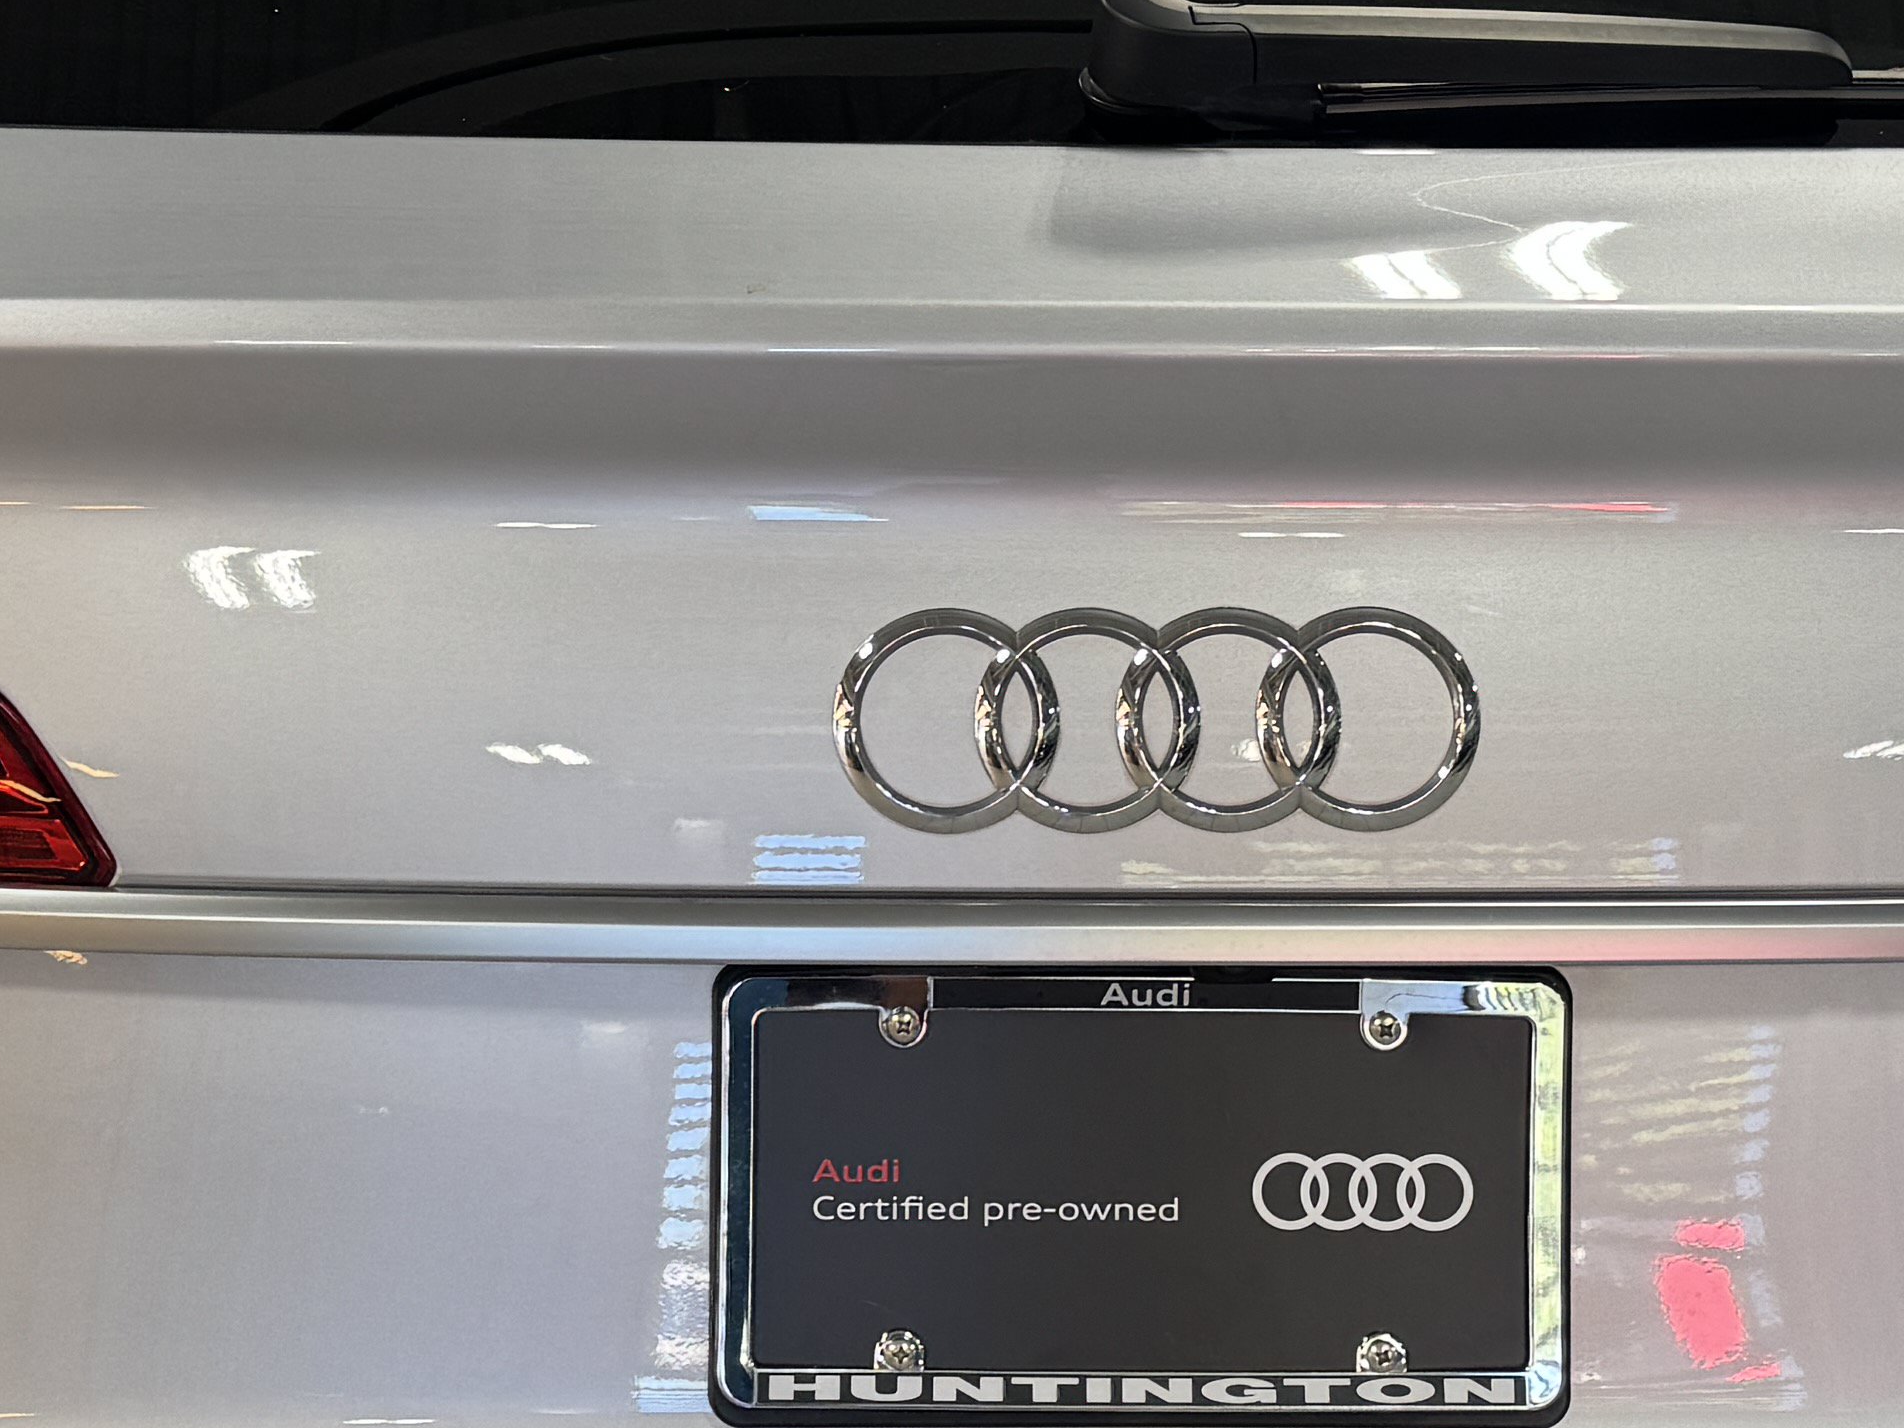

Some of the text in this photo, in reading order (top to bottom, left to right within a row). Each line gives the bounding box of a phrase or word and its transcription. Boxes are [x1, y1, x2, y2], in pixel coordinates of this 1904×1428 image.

[1100, 982, 1191, 1007] Audi
[812, 1158, 901, 1183] Audi
[812, 1195, 1180, 1226] Certified pre-owned
[768, 1374, 1516, 1404] HUNTINGTON
